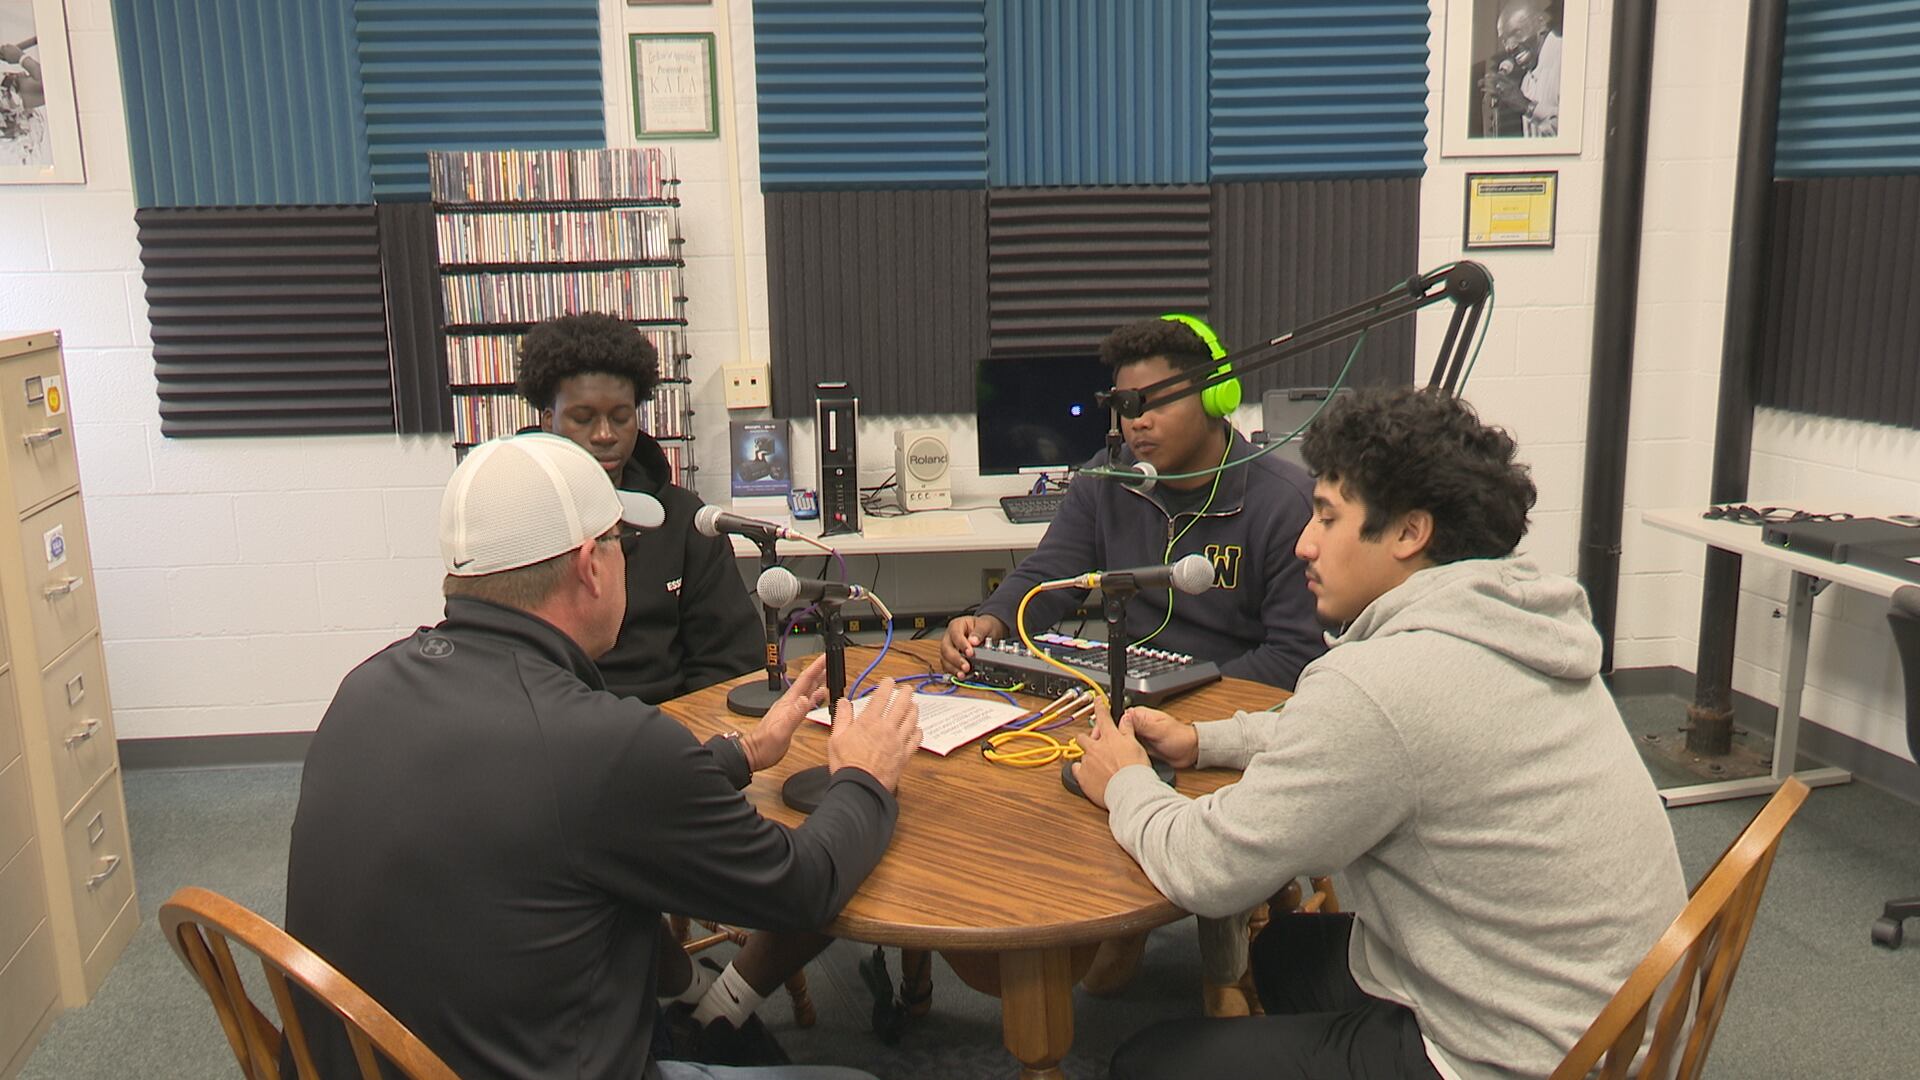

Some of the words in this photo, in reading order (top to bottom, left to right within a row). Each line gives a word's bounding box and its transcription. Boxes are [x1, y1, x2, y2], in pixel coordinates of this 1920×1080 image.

[650, 76, 696, 94] KALA
[909, 454, 948, 465] Roland
[1204, 544, 1242, 589] W
